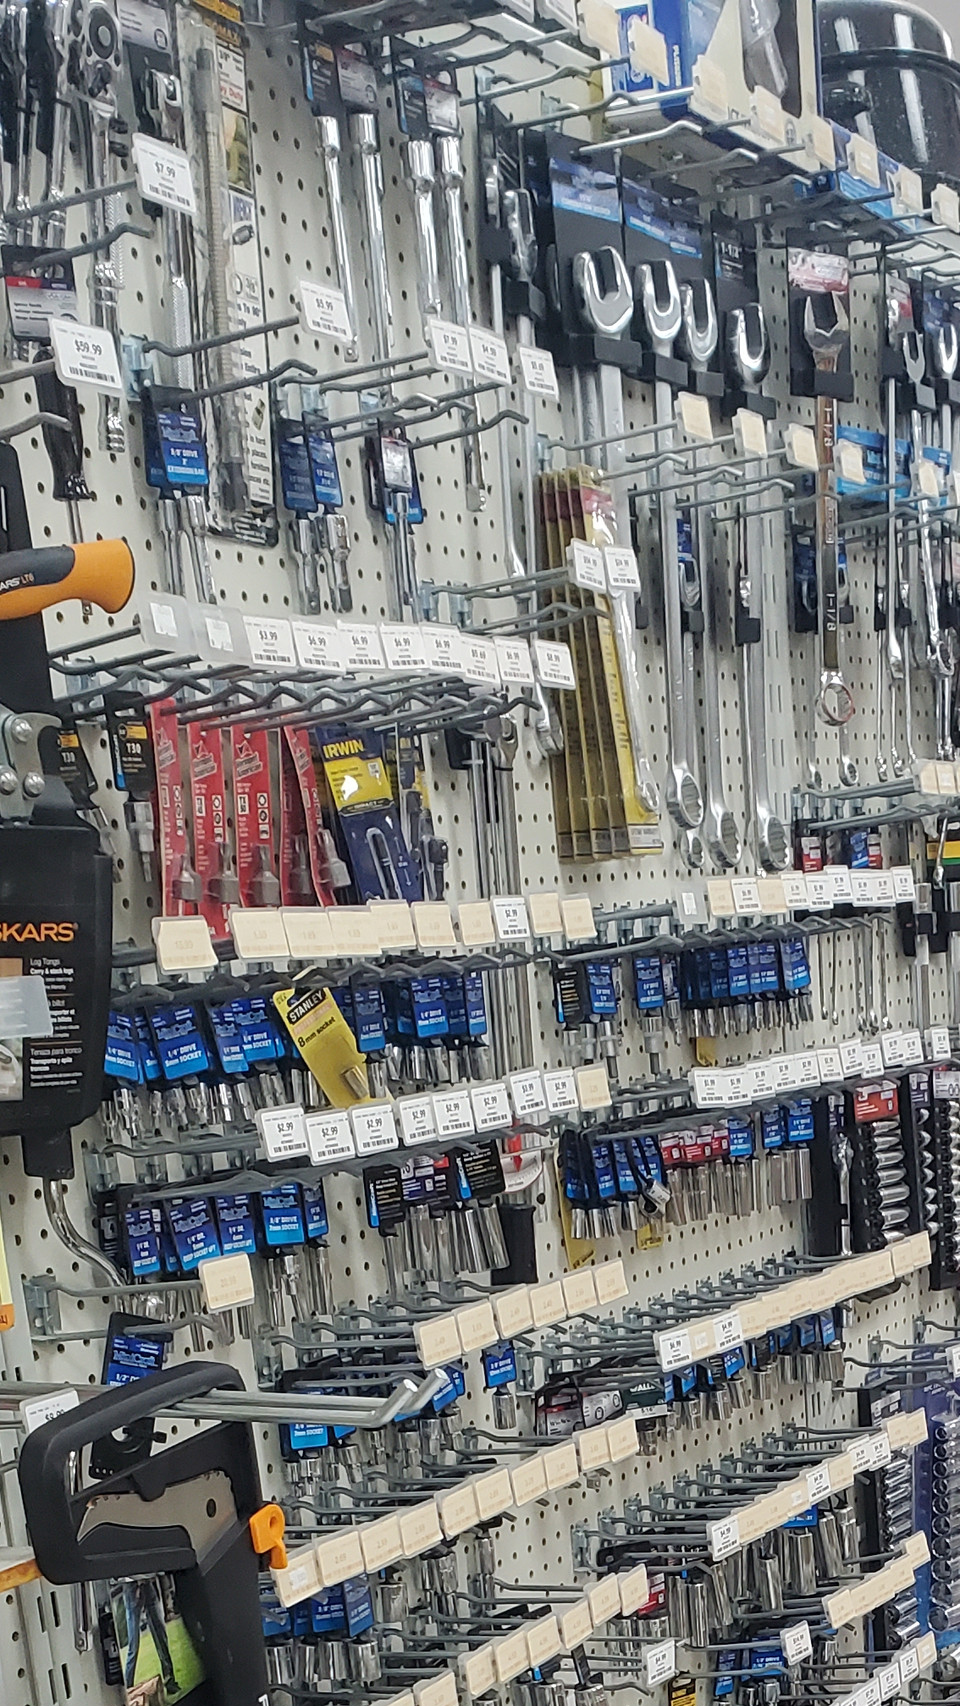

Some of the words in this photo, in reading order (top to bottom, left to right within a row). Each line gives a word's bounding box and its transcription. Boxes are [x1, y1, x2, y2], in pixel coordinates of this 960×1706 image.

[323, 739, 364, 759] IRWIN
[289, 990, 324, 1023] STANLEY
[316, 1016, 336, 1036] socket
[277, 1122, 294, 1133] $2.99
[366, 1117, 383, 1129] $2.99
[321, 1126, 338, 1137] $2.99
